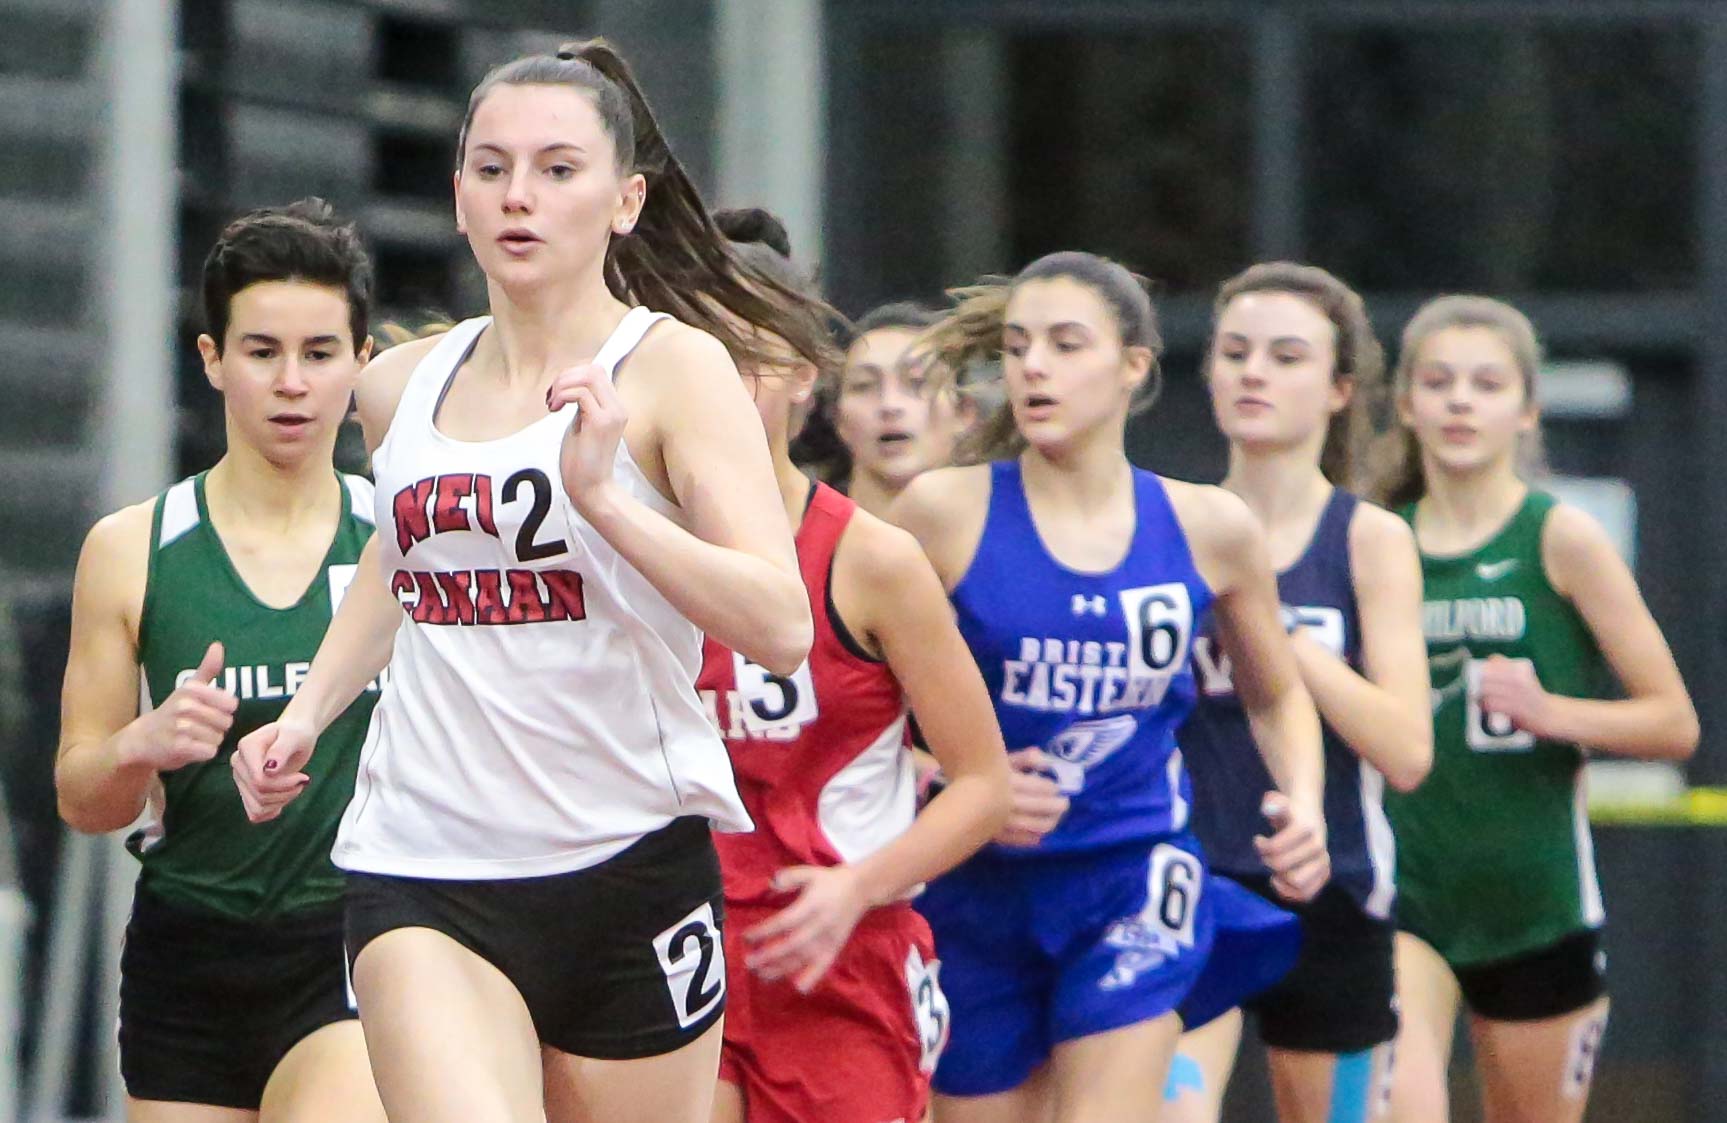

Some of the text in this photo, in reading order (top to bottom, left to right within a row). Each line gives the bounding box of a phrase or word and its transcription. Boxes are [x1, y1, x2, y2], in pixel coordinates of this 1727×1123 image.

[501, 468, 568, 563] 2
[392, 569, 586, 626] CANAAN
[1139, 591, 1181, 670] 6
[1019, 636, 1126, 666] BRIST
[1160, 859, 1194, 931] 6
[667, 920, 722, 1017] 2
